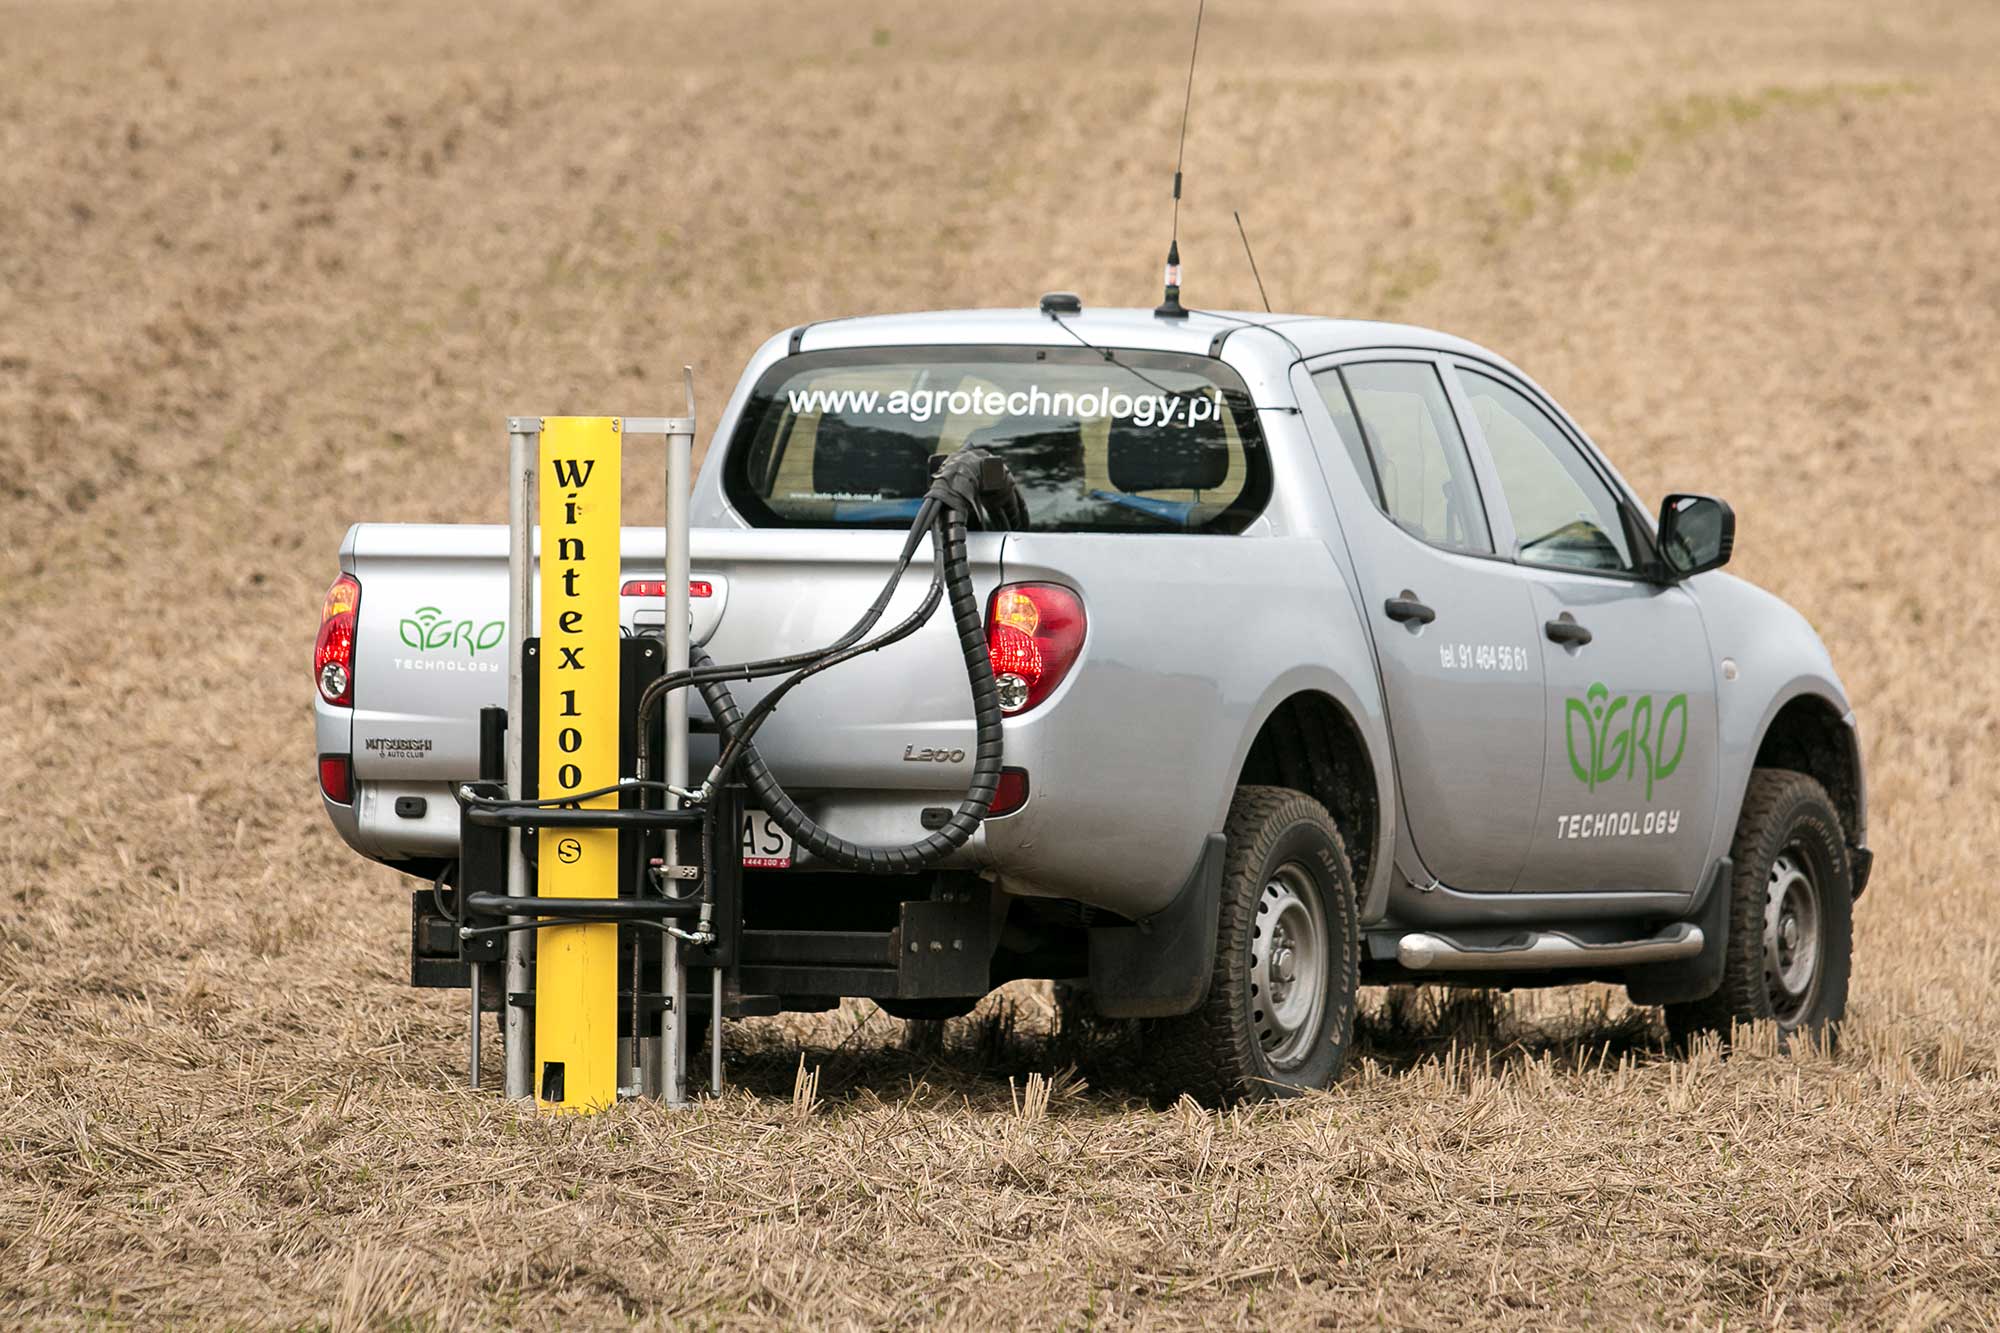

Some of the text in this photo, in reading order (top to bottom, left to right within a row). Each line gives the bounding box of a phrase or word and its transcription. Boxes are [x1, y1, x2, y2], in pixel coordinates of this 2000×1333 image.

[787, 384, 1223, 428] www.agrotechnology.pl
[552, 459, 595, 670] Wintex
[394, 658, 499, 673] TECHNOLOGY
[1459, 644, 1473, 669] 91
[1476, 645, 1497, 670] 464
[1514, 645, 1528, 671] 61
[365, 738, 433, 751] MITSUBISHI
[903, 743, 965, 763] L200
[1557, 809, 1680, 840] TECHNOLOGY
